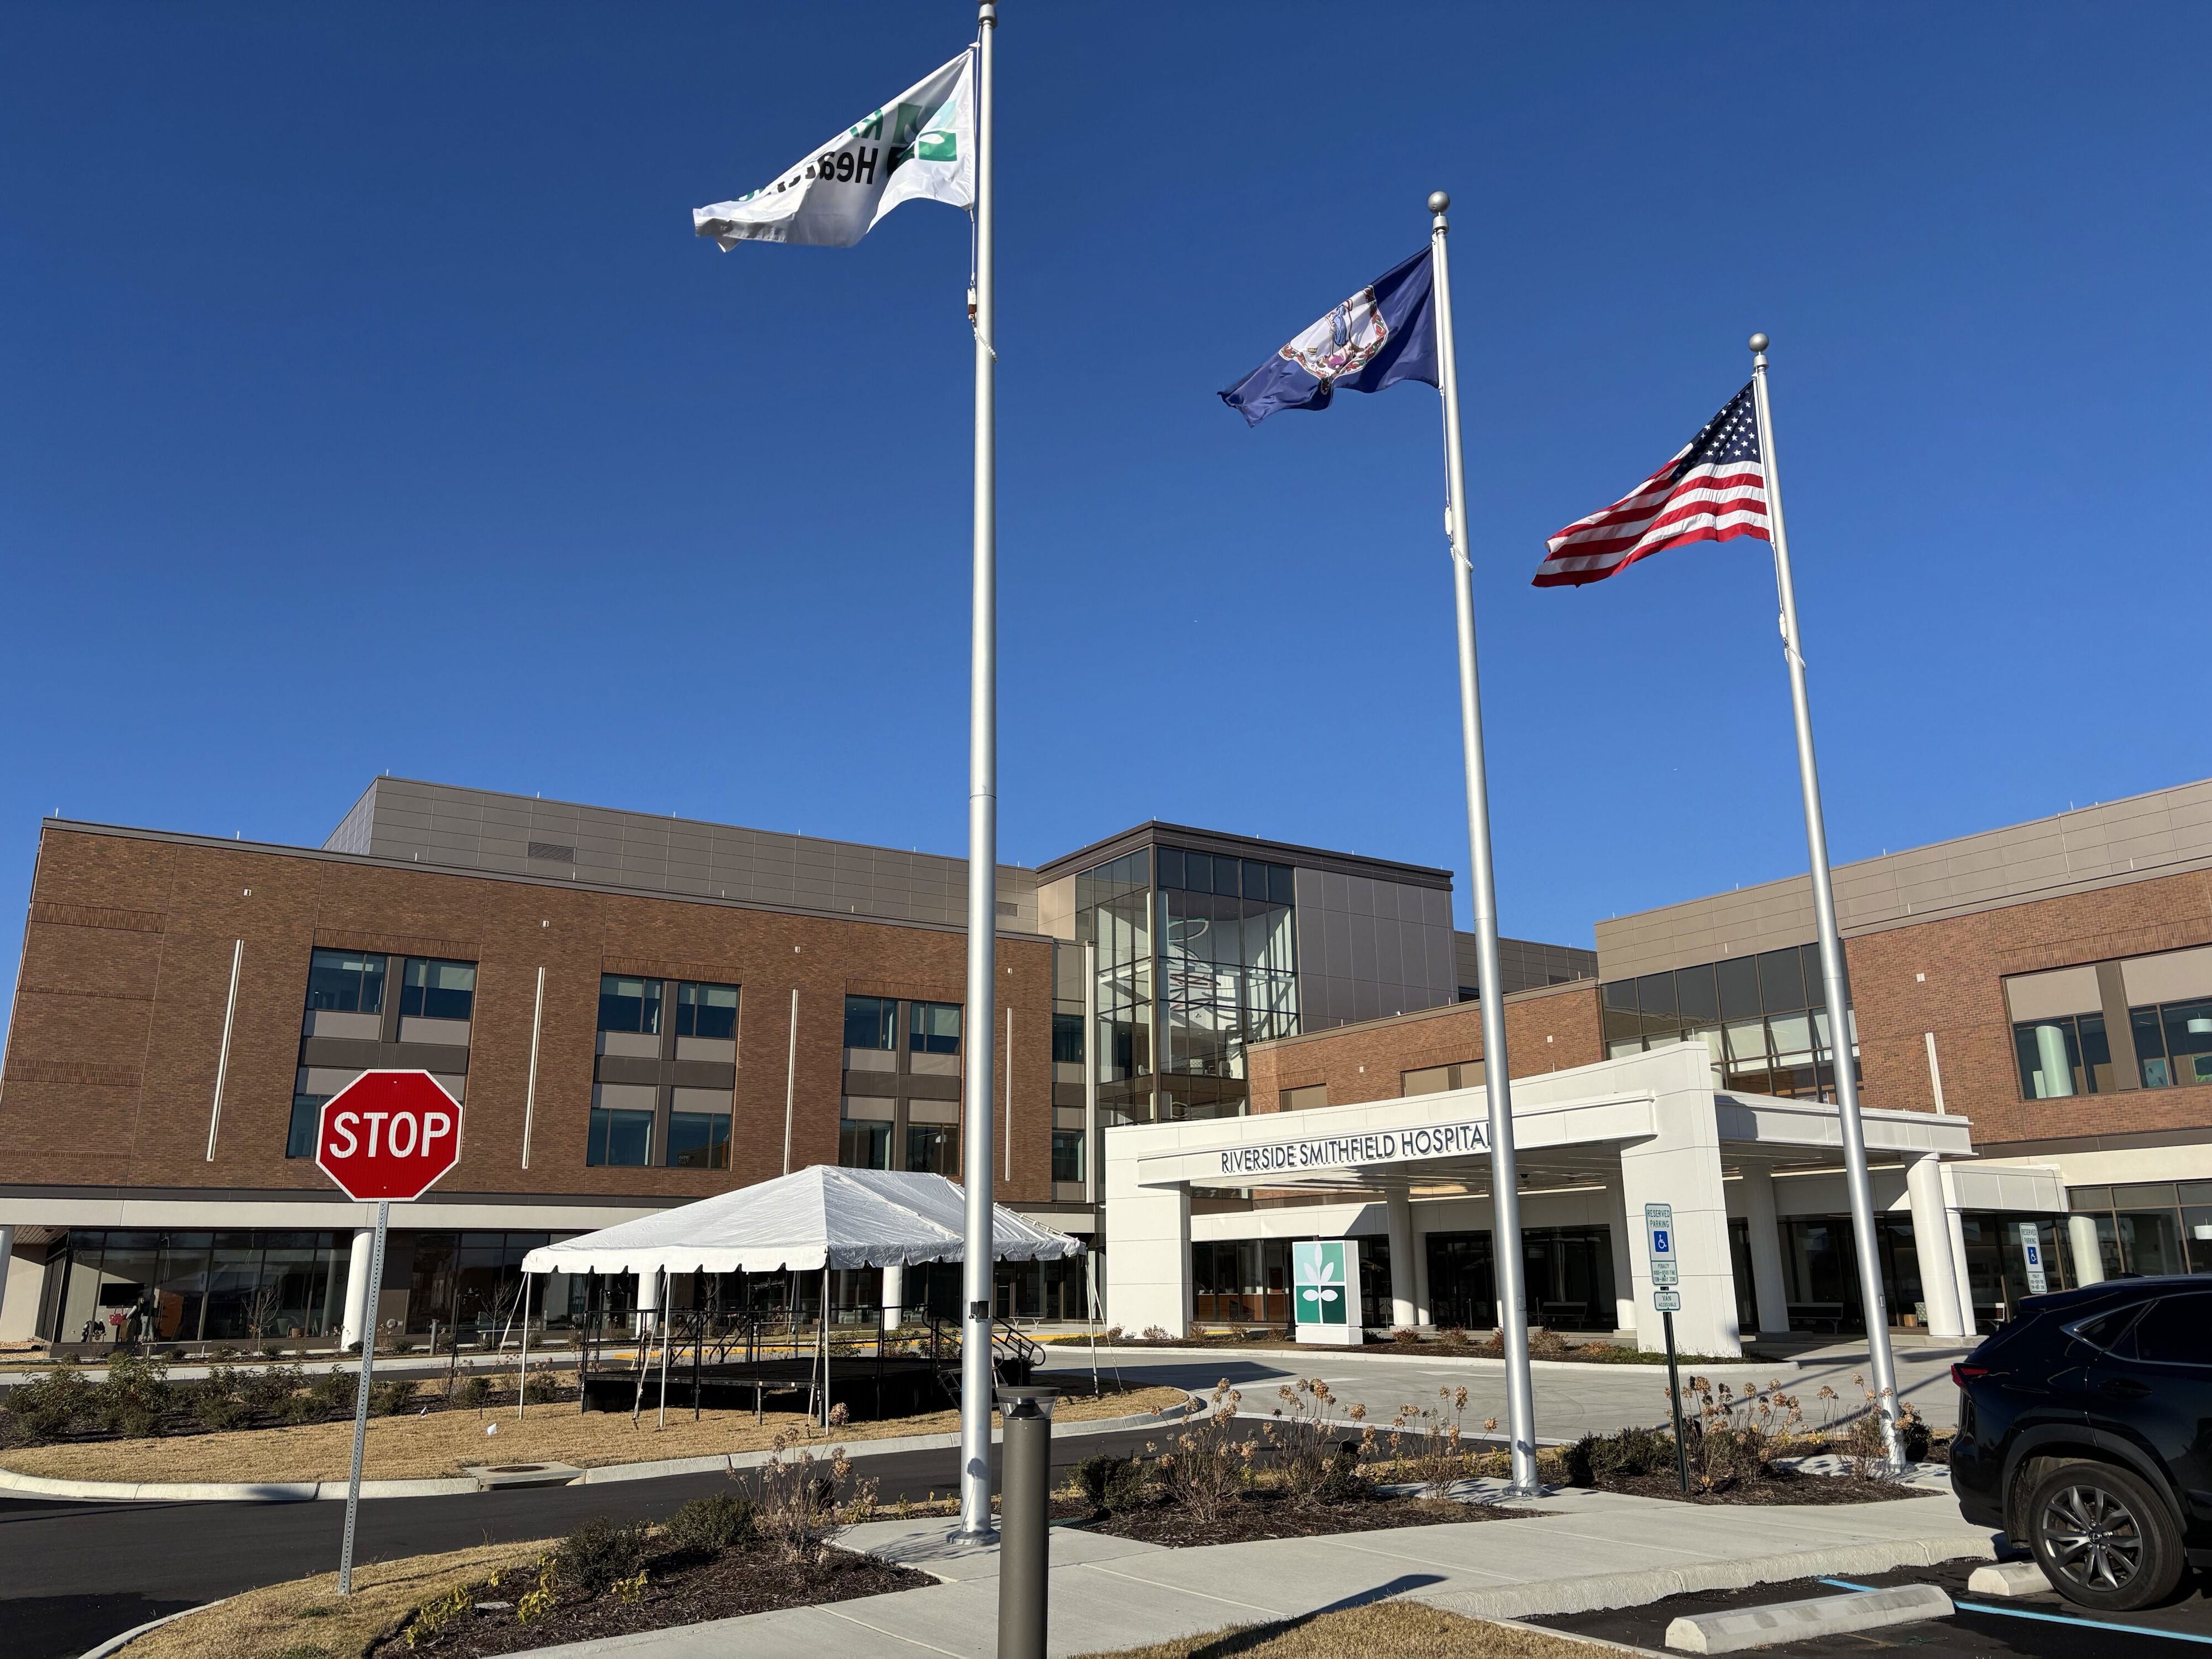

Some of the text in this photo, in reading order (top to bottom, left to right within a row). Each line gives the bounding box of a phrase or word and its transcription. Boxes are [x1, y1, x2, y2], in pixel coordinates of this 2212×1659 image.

[329, 1111, 451, 1158] STOP
[1221, 1123, 1491, 1172] RIVERSIDE SMITHFIELD HOSPITAL
[1647, 1209, 1670, 1218] RESERVED
